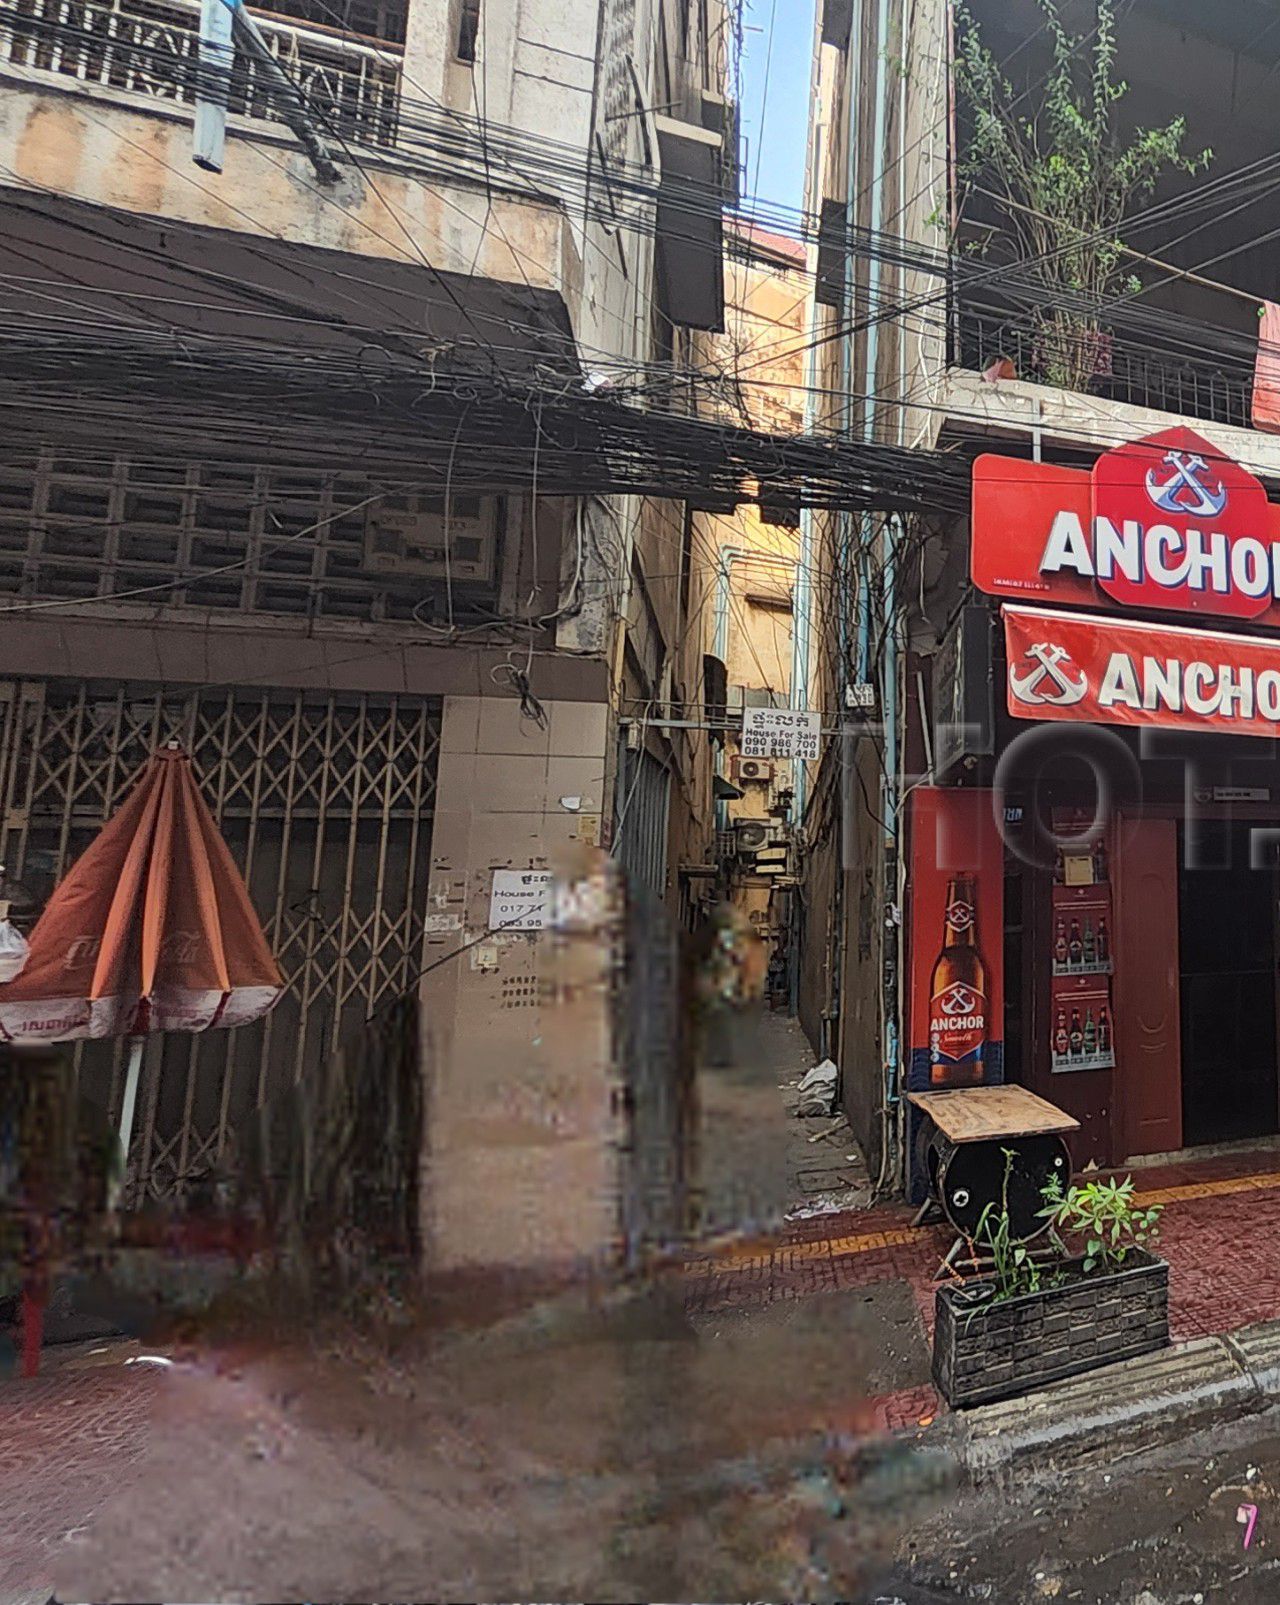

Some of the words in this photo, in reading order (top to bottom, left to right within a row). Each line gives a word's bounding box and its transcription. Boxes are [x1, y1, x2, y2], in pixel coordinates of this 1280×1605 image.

[746, 728, 777, 738] House
[779, 730, 794, 739] For
[797, 731, 817, 740] Sale
[745, 737, 767, 747] 090
[771, 738, 792, 748] 986
[796, 740, 816, 749] 700
[745, 746, 766, 756] 081
[795, 749, 816, 759] 418
[930, 1015, 984, 1031] ANCHOR
